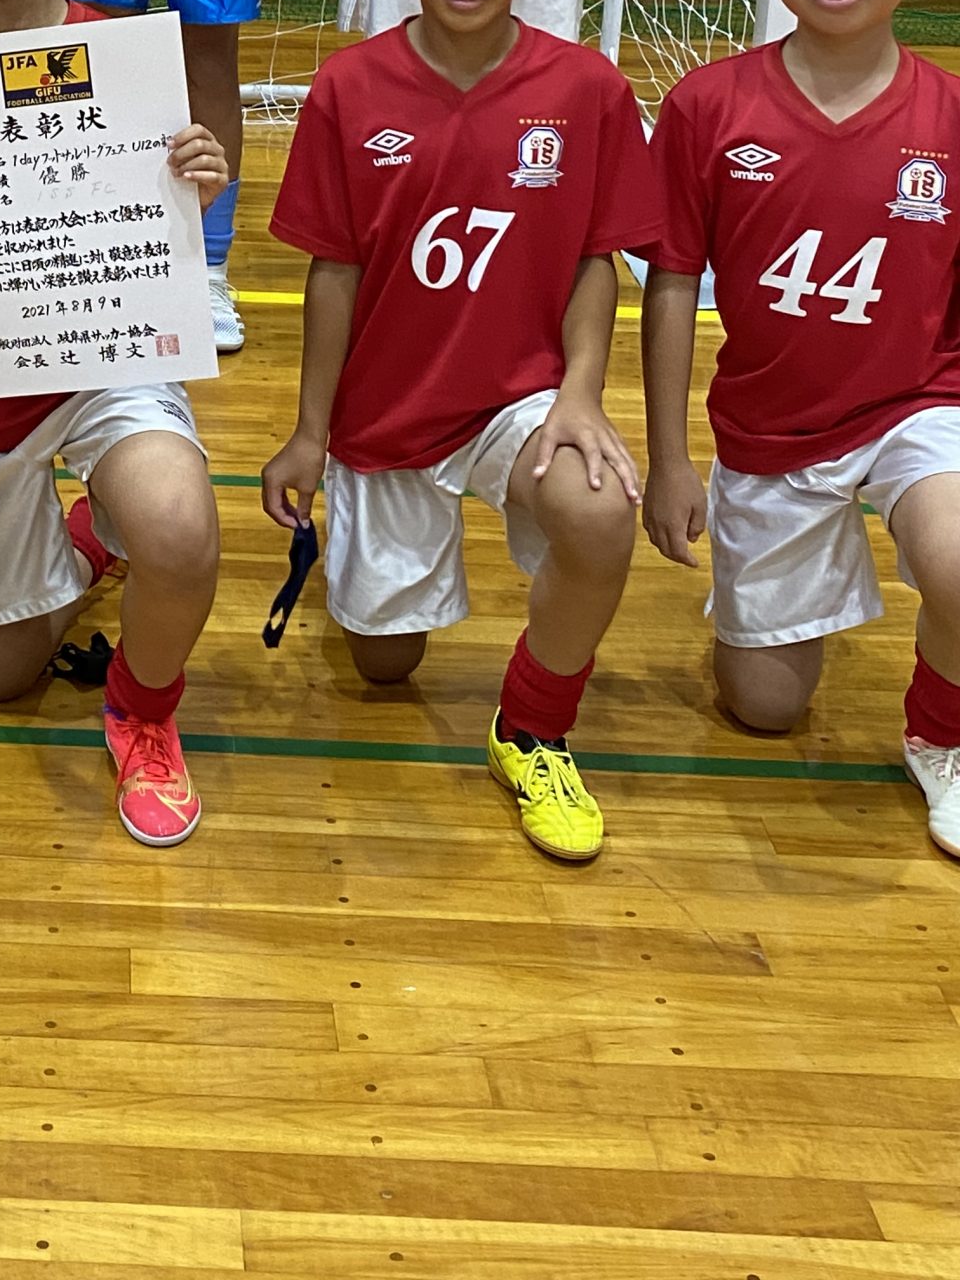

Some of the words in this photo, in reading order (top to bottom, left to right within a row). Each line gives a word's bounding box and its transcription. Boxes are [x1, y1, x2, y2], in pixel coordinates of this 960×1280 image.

[6, 55, 38, 70] JFA
[7, 96, 43, 108] FOOTBALL
[45, 91, 92, 103] ASSOCIATION
[35, 86, 62, 97] GIFU
[0, 107, 107, 143] 表彰状
[373, 153, 412, 167] umbro
[39, 163, 90, 185] 優勝
[730, 169, 774, 182] umbro
[411, 206, 516, 292] 67
[758, 229, 888, 324] 44
[57, 322, 158, 345] 岐阜県サッカー協会
[14, 353, 50, 368] 会長
